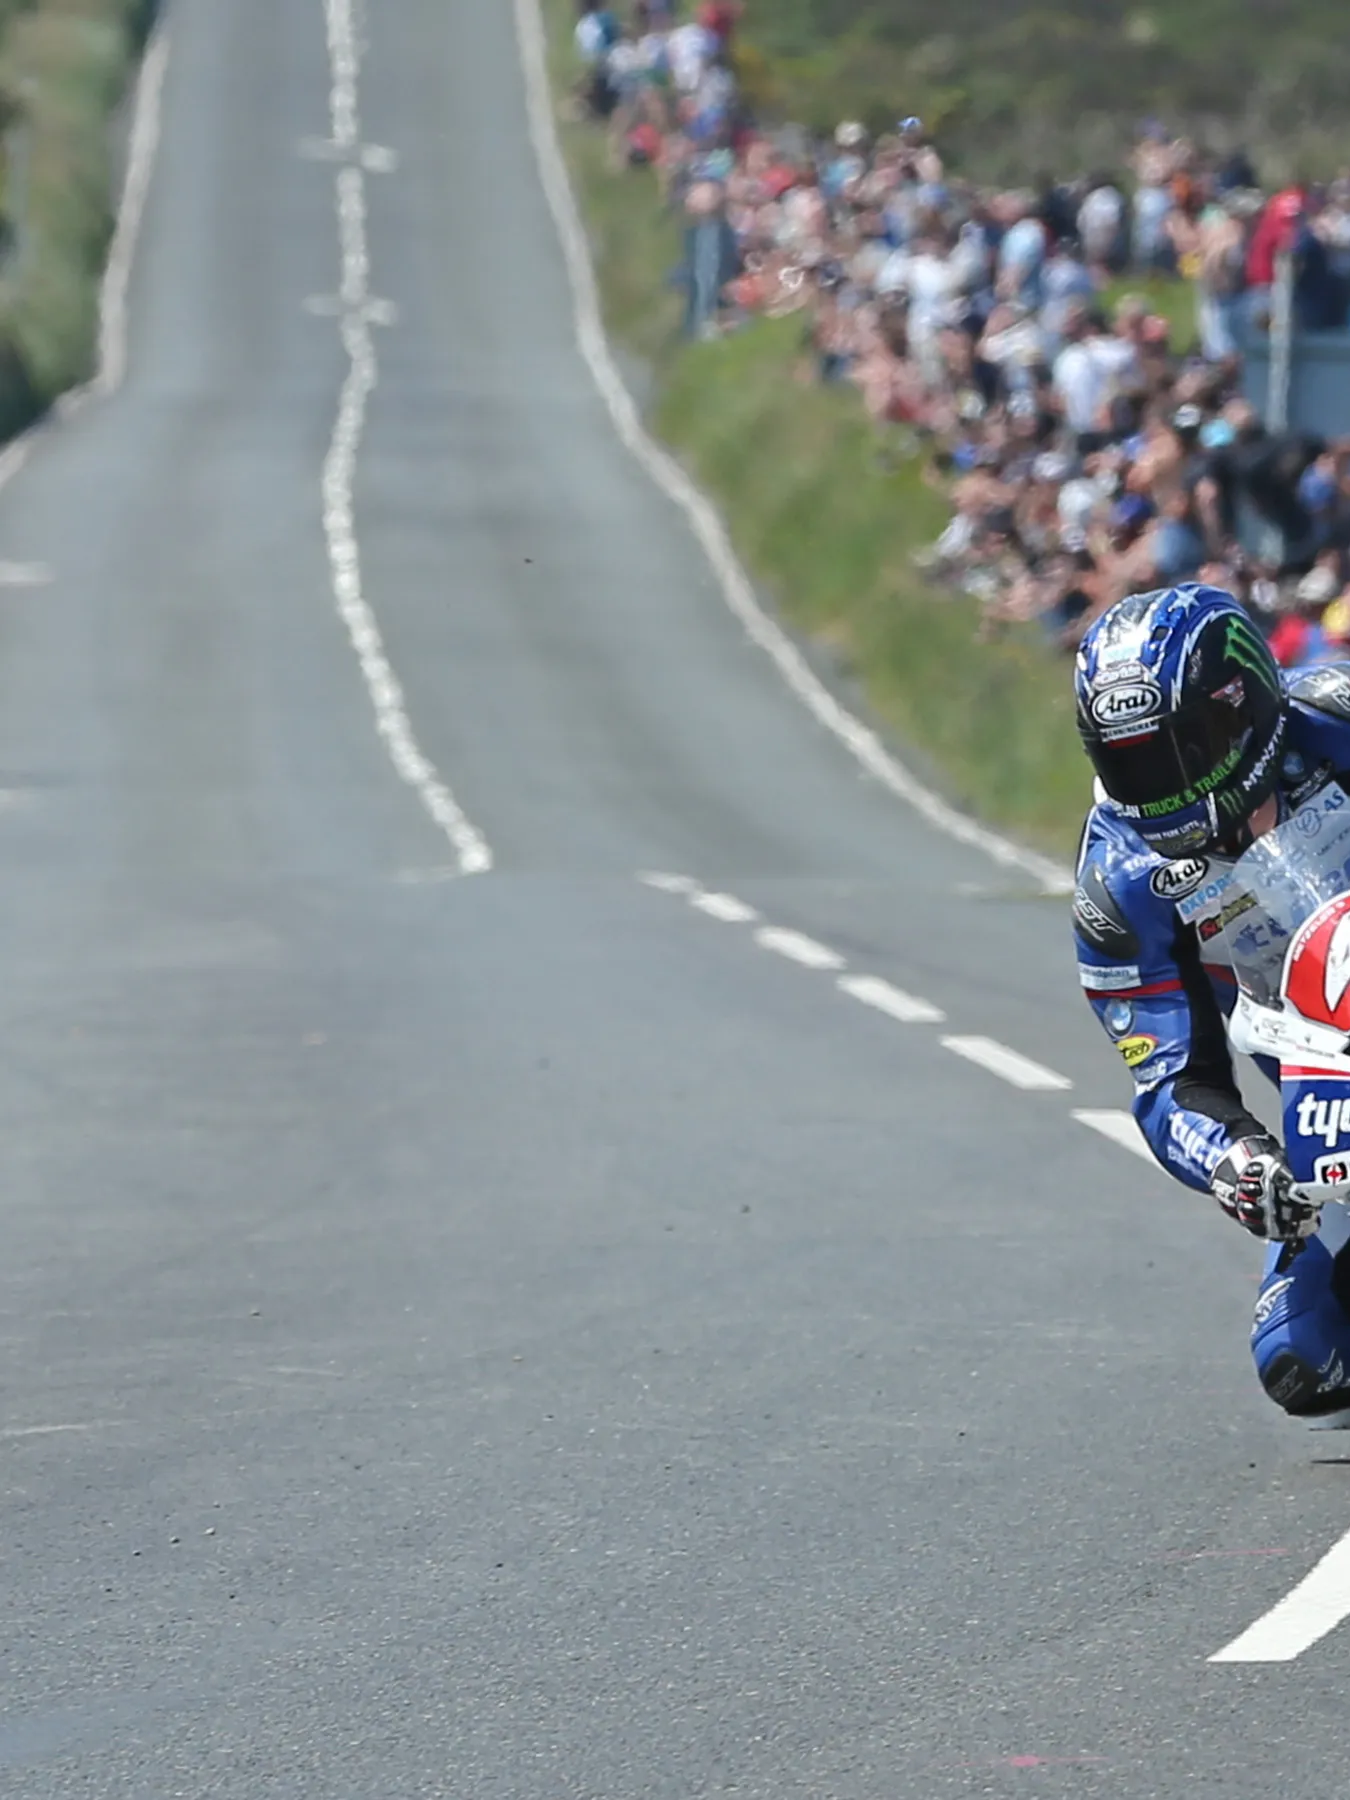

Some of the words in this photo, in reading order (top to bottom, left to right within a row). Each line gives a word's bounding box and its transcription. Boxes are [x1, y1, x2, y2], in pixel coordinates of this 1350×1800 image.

[1099, 688, 1148, 714] Arai
[1141, 794, 1184, 817] TRUCK
[1183, 788, 1197, 803] &
[1161, 857, 1203, 892] Arai
[1074, 886, 1127, 934] RST
